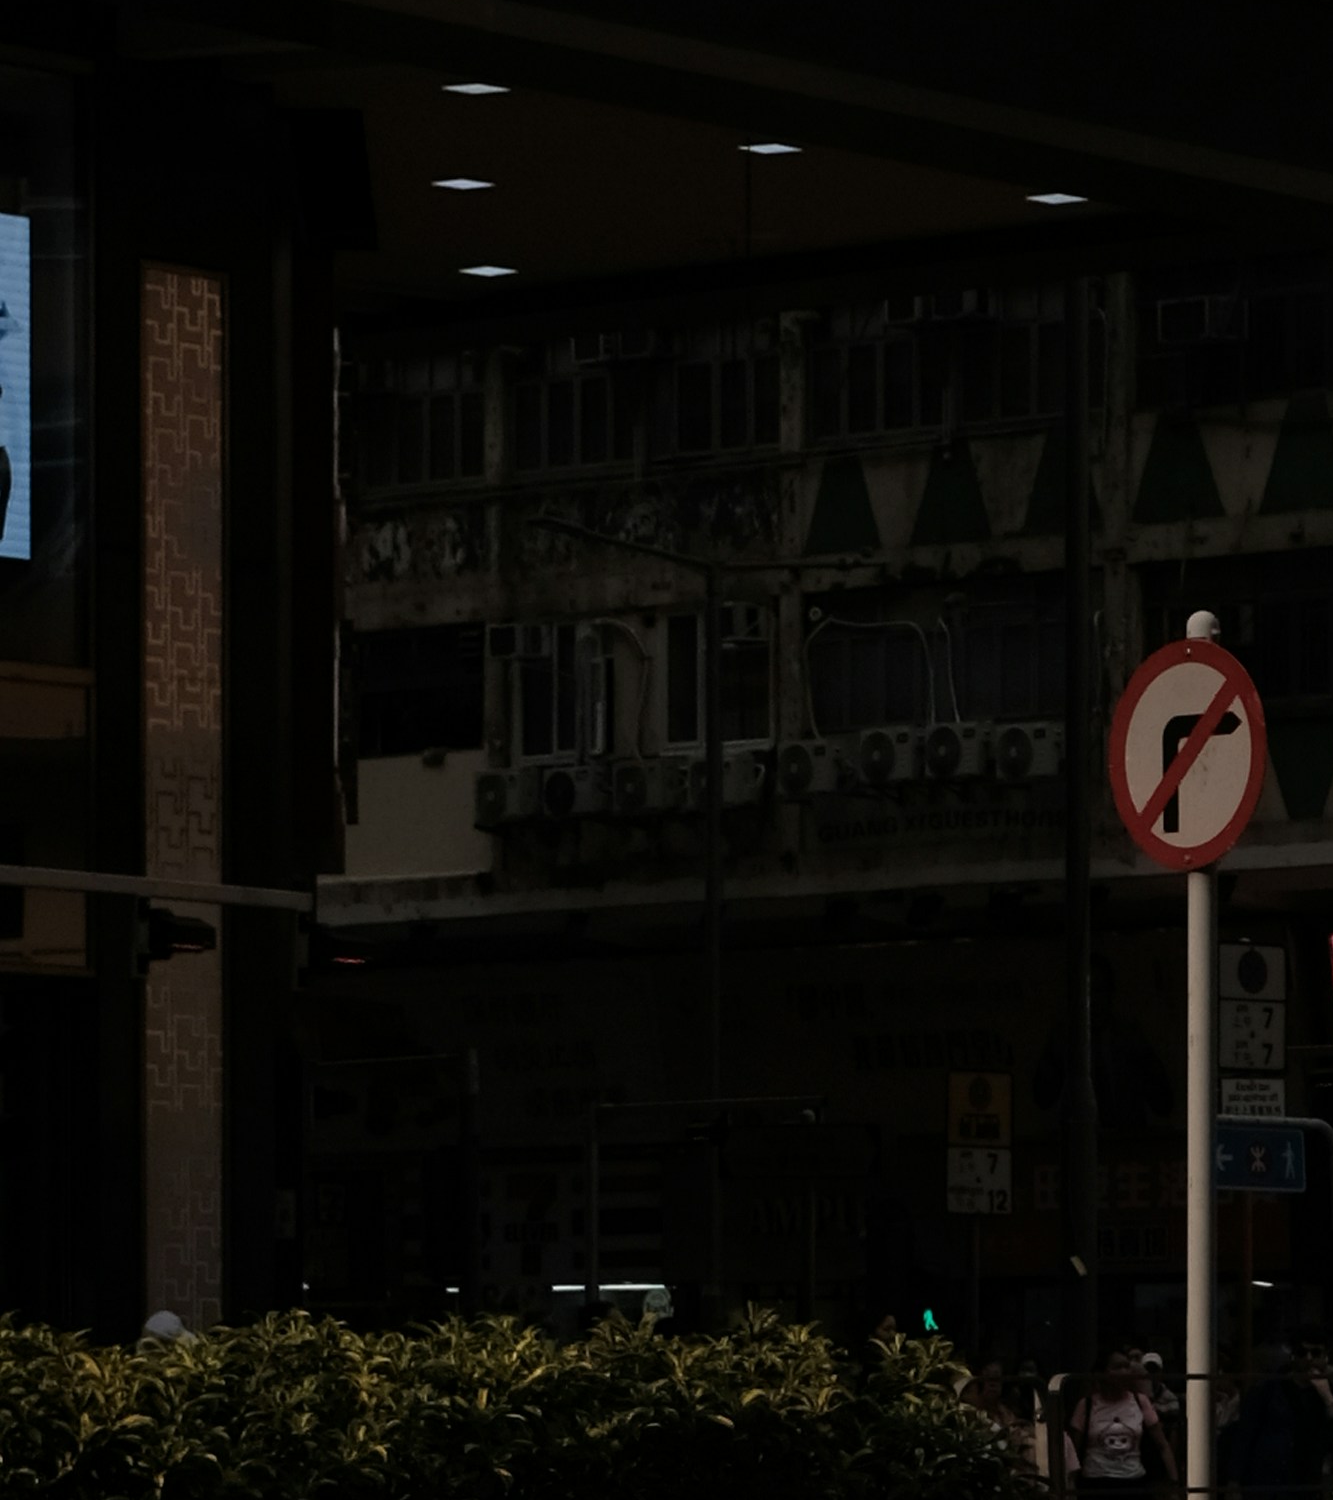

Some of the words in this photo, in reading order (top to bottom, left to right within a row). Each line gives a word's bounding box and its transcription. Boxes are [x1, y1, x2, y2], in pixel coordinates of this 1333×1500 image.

[1262, 1007, 1274, 1028] 7
[1262, 1043, 1274, 1065] 7
[987, 1152, 999, 1175] 7
[988, 1189, 1008, 1212] 12
